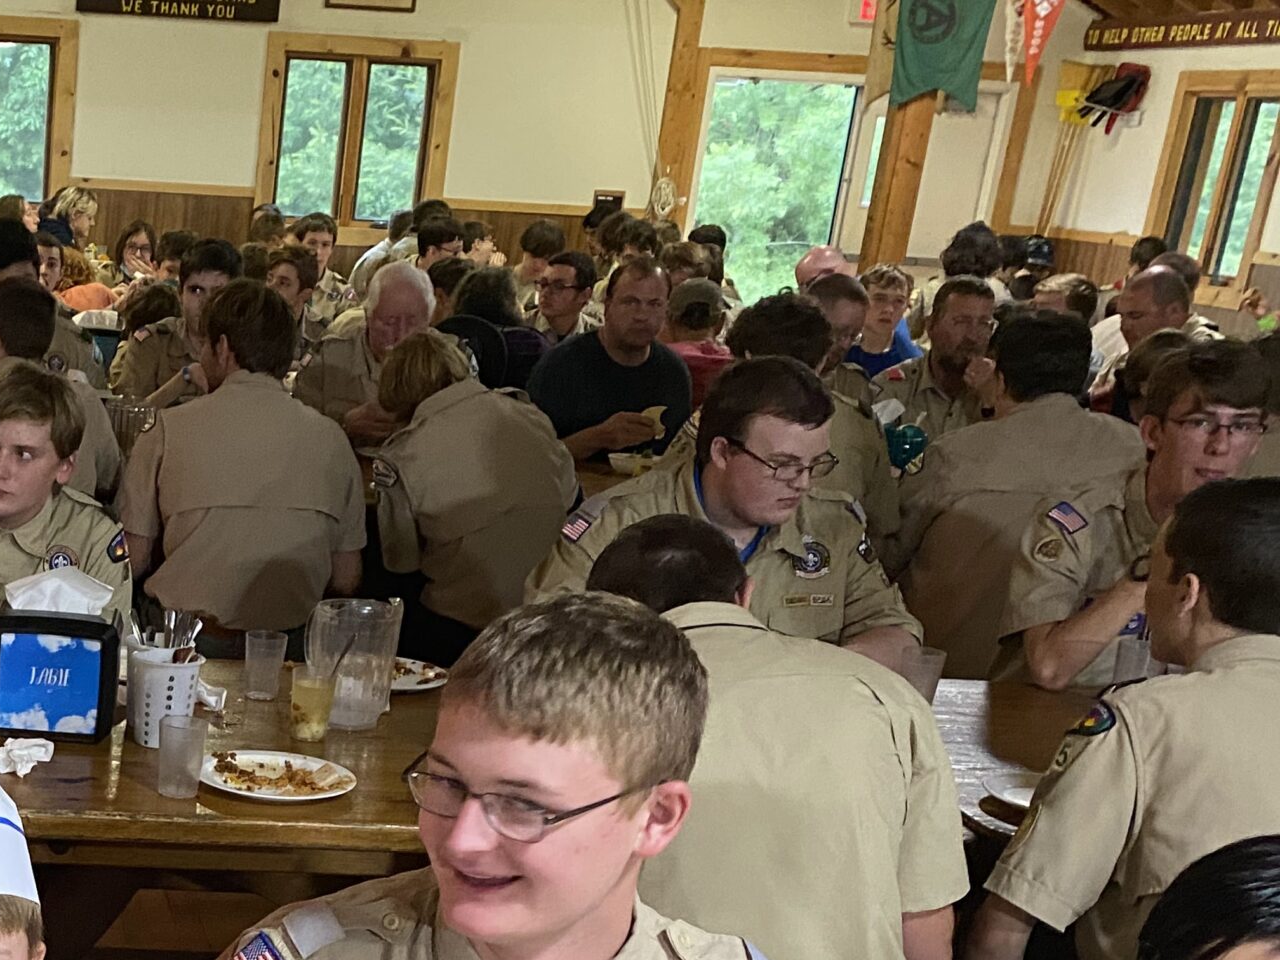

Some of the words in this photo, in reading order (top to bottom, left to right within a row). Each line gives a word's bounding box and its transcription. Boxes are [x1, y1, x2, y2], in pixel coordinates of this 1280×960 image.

[121, 0, 142, 13] WE
[150, 1, 199, 16] THANK
[206, 5, 235, 19] YOU
[1087, 29, 1100, 45] TO
[1102, 27, 1129, 45] HELP
[1131, 25, 1166, 44] OTHER
[1169, 23, 1212, 42] PEOPLE
[1214, 21, 1232, 40] AT
[1235, 20, 1258, 39] ALL
[1266, 19, 1280, 38] TI
